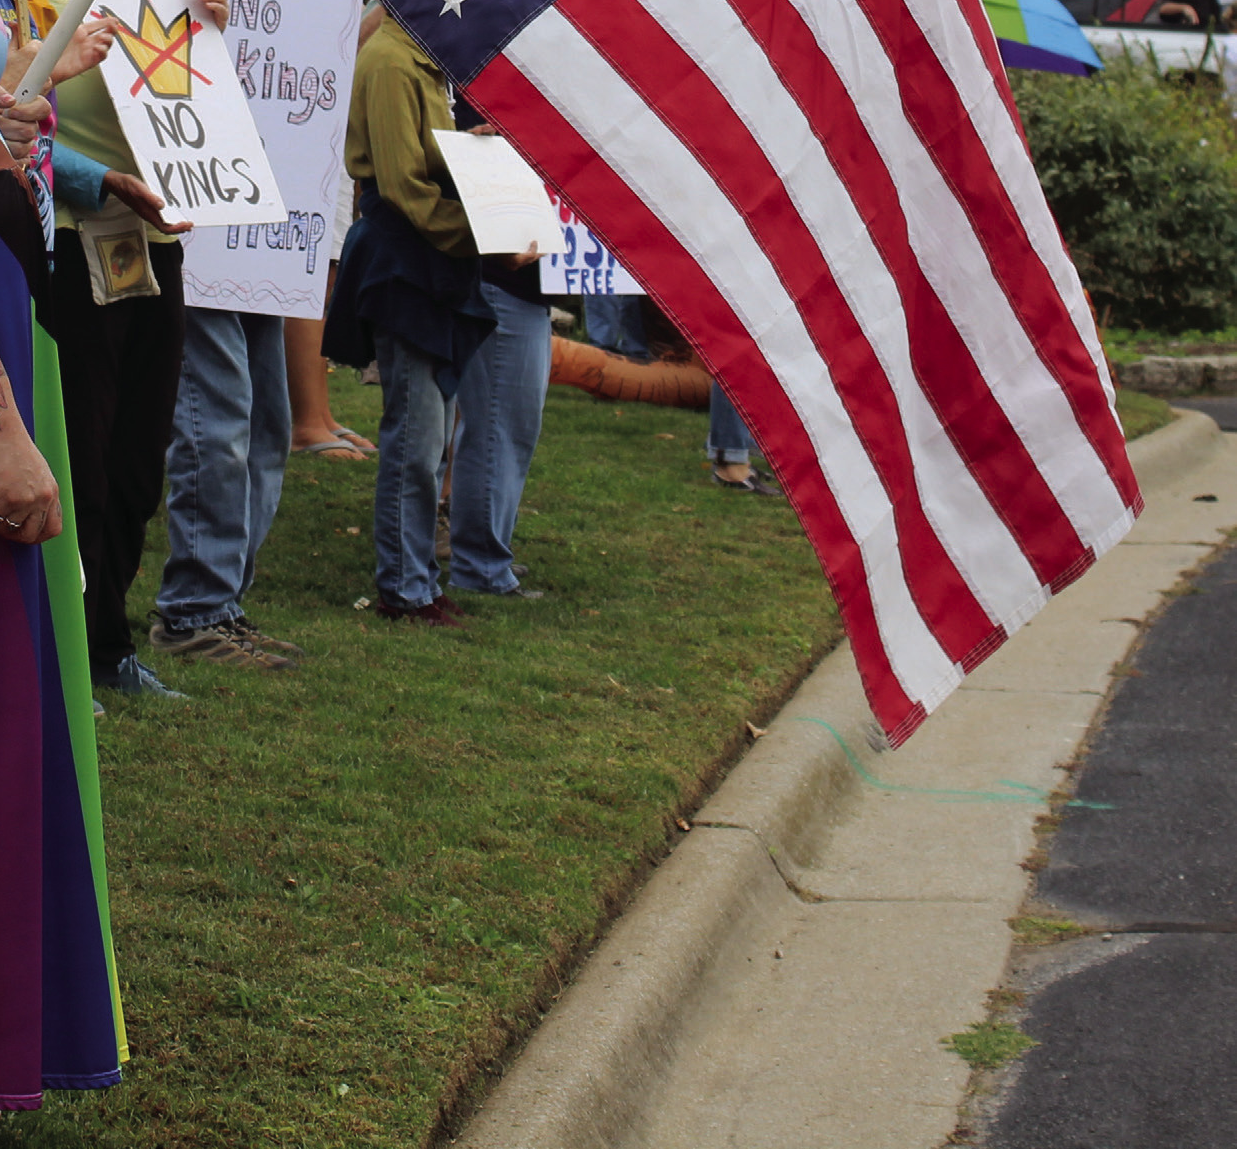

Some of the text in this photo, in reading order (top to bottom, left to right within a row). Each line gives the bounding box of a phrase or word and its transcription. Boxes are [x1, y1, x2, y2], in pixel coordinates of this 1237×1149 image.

[142, 101, 206, 150] NO
[152, 156, 261, 209] KINGS
[564, 268, 616, 295] FREE
